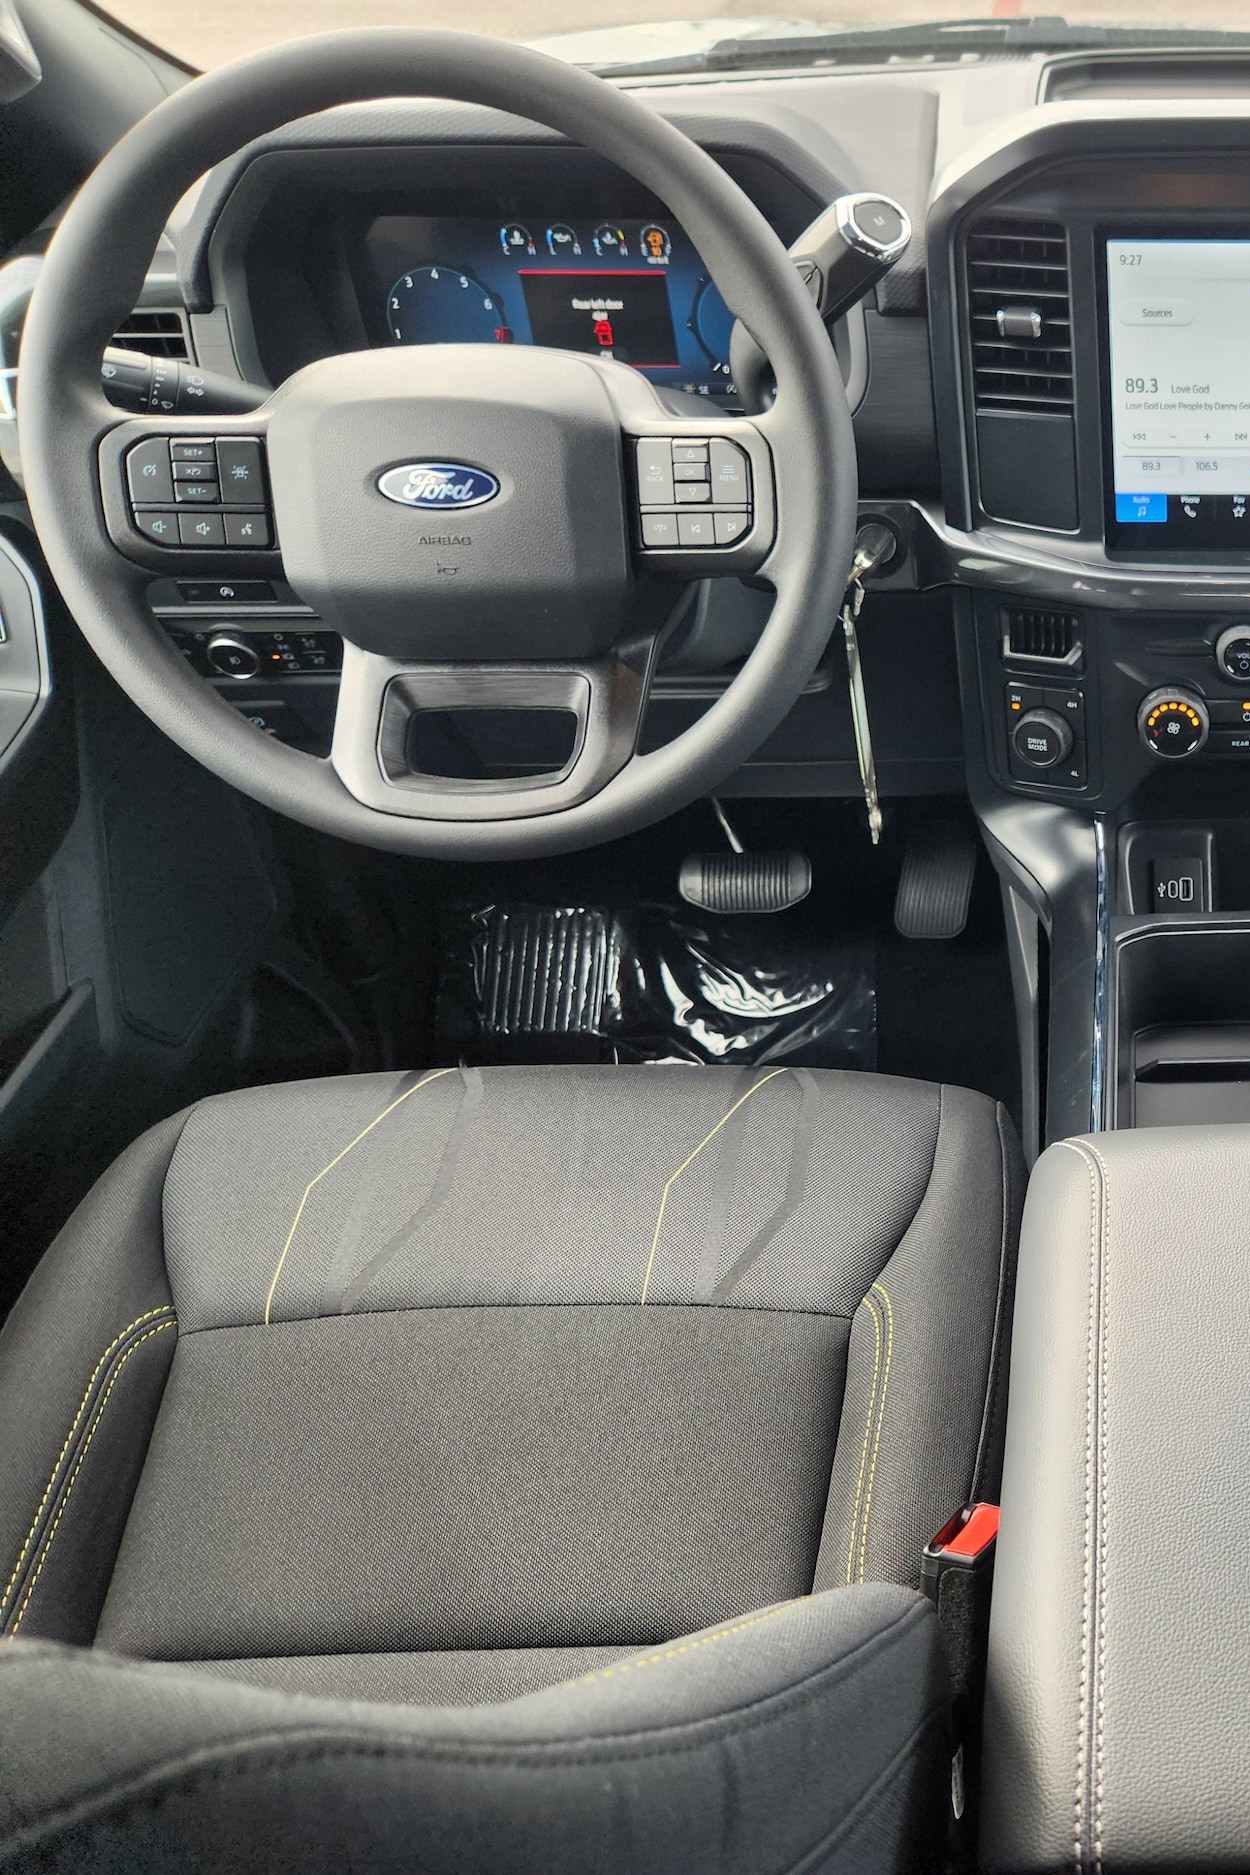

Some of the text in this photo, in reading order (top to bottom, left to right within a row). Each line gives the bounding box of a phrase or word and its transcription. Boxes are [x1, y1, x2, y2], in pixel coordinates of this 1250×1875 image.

[1119, 254, 1143, 266] 9:27
[430, 268, 439, 280] 4
[404, 276, 414, 288] 3
[460, 276, 469, 288] 5
[391, 298, 400, 310] 2
[483, 298, 493, 310] 6
[1142, 308, 1173, 318] Sources
[394, 328, 402, 340] 1
[1125, 378, 1210, 394] 89.3 Love God
[1126, 402, 1143, 411] Love
[1143, 402, 1159, 411] God
[1160, 402, 1177, 411] Love
[1178, 402, 1203, 412] People
[1205, 402, 1213, 412] by
[1214, 402, 1238, 412] Danny
[1142, 462, 1161, 471] 89.3
[1195, 462, 1218, 471] 106.5
[719, 474, 739, 482] MENU
[402, 469, 475, 500] Ford
[1180, 495, 1200, 504] Phone
[418, 536, 472, 546] AIRBAG
[1067, 701, 1078, 709] 4H
[1027, 737, 1048, 746] DRIVE
[1027, 744, 1048, 752] MODE
